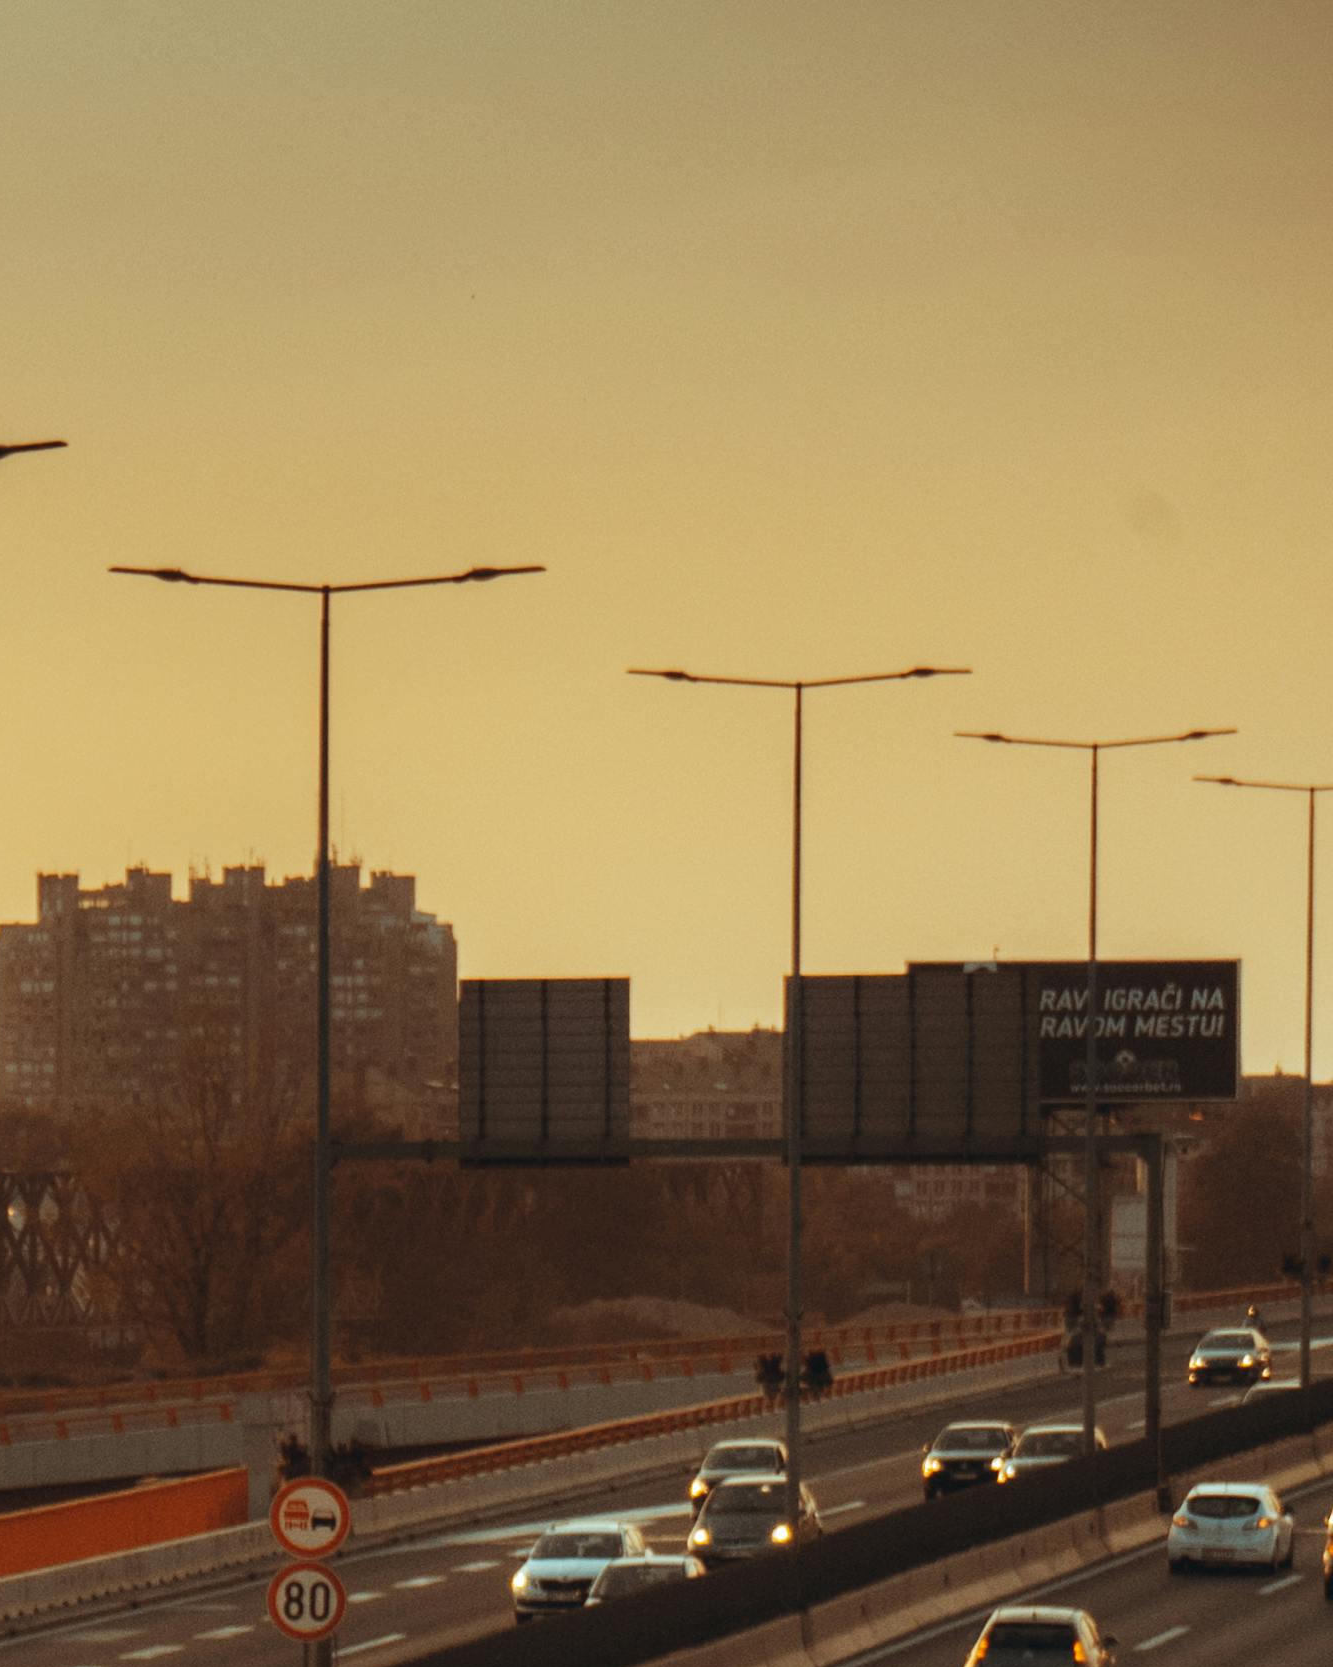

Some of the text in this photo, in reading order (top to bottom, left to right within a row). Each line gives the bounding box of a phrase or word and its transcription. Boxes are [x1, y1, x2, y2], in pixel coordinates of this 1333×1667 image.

[1040, 982, 1225, 1011] RAV IGRAČI NA
[1040, 1015, 1225, 1038] RAVOM MESTU!
[285, 1582, 330, 1620] 80
